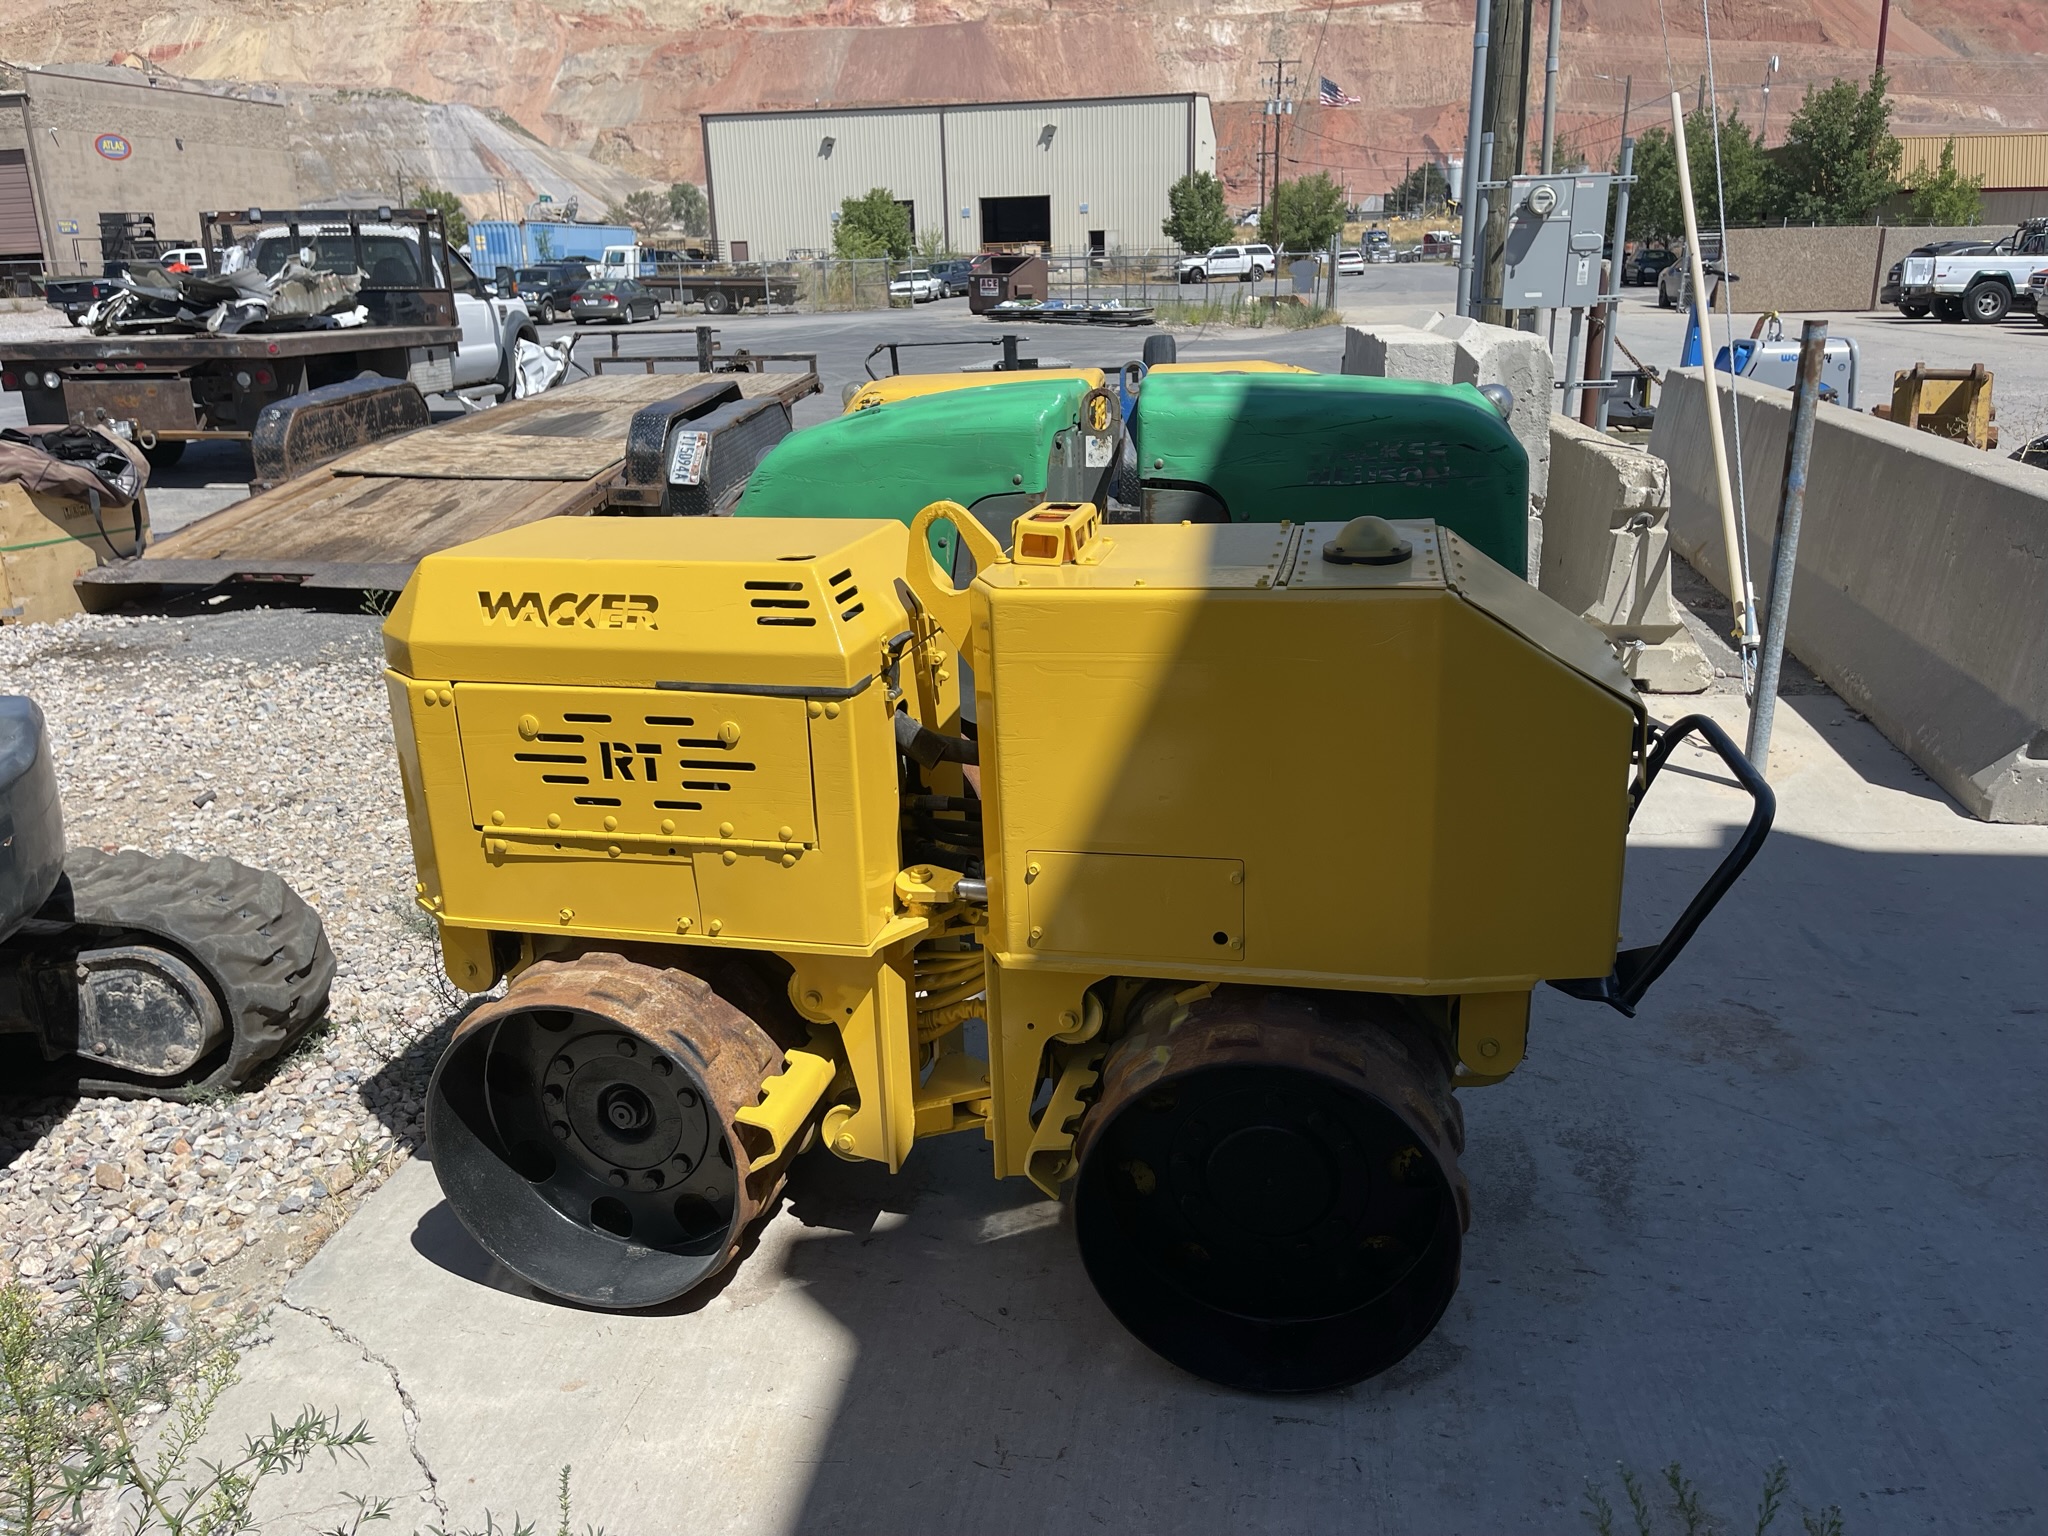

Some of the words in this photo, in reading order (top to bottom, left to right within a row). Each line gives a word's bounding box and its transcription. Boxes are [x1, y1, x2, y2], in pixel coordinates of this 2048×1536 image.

[103, 140, 124, 150] ATLAS
[981, 279, 997, 287] ACE
[478, 591, 659, 630] WACKER
[598, 741, 663, 783] RT
